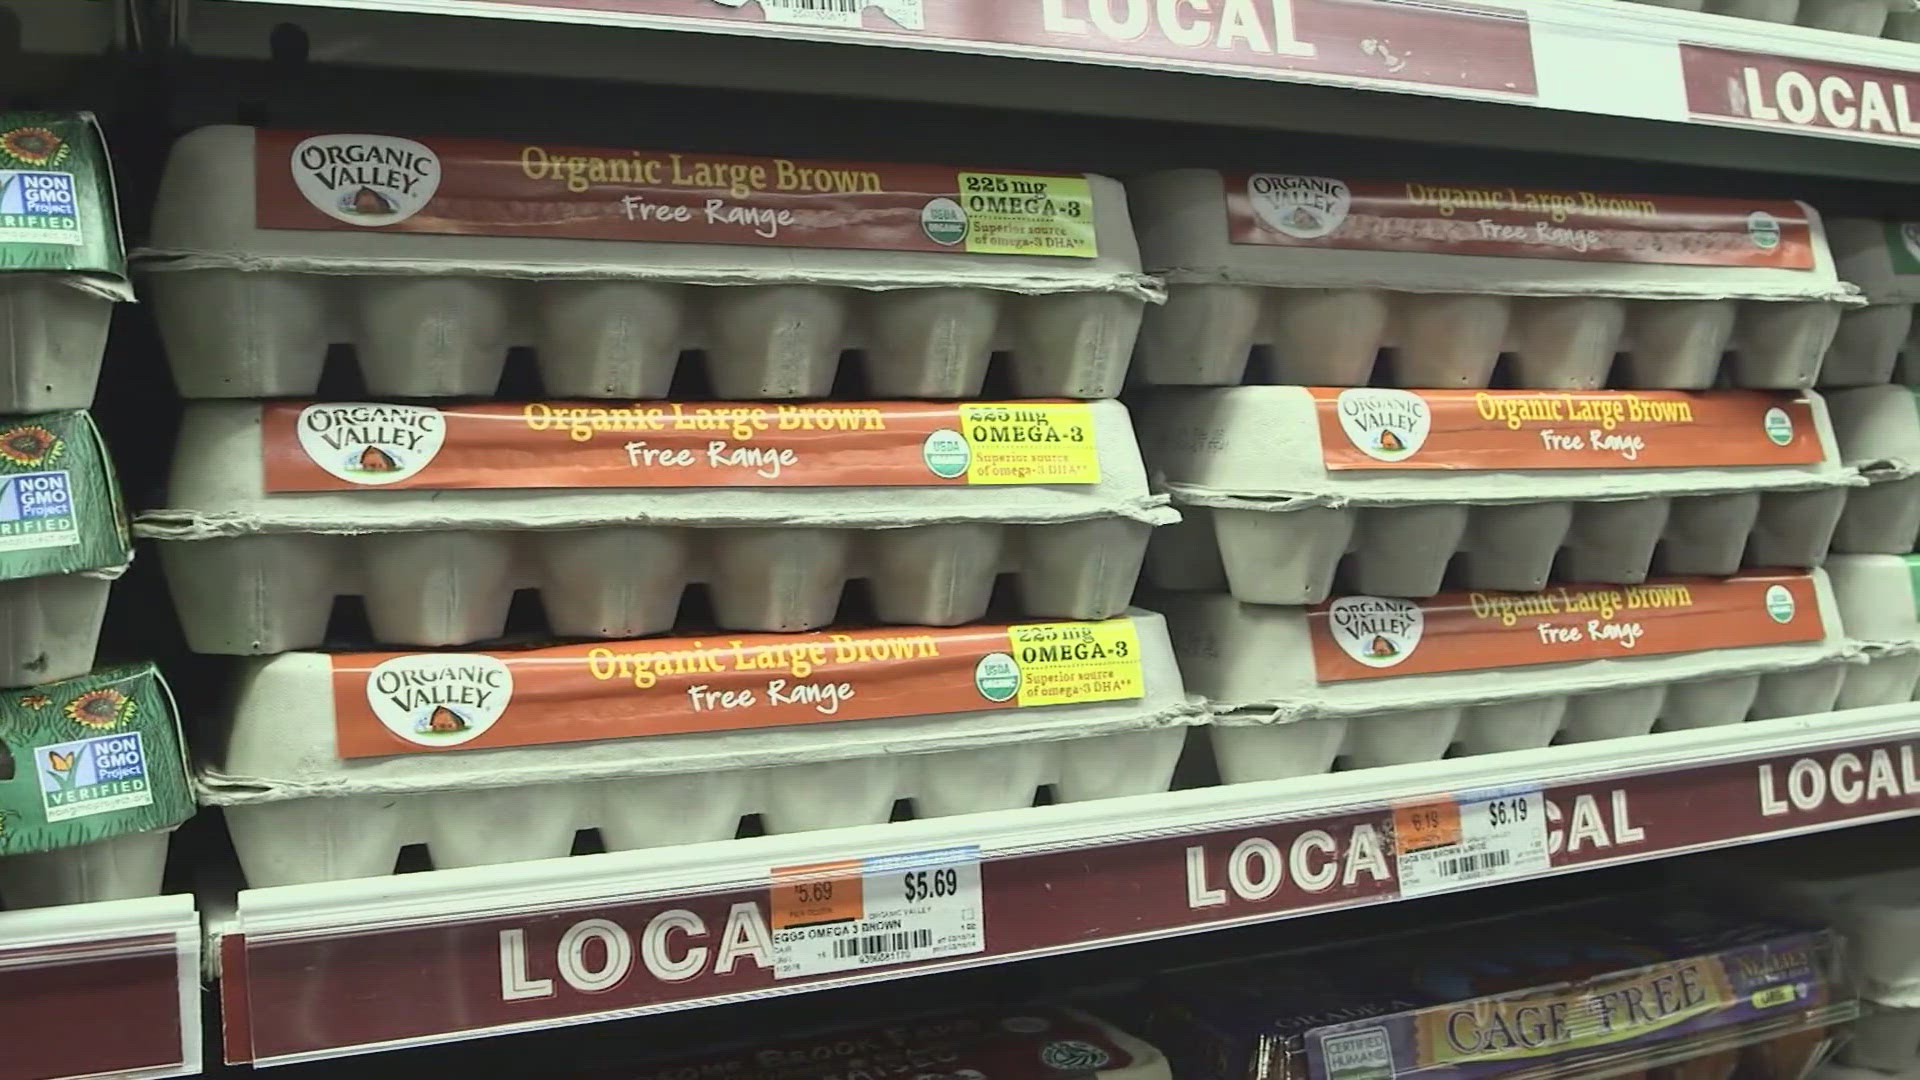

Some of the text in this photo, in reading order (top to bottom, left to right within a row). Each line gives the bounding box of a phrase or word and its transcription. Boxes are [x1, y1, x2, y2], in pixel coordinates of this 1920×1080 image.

[1043, 0, 1316, 56] LOCAL
[1744, 67, 1920, 134] LOCAL
[301, 145, 432, 176] ORGANIC
[521, 146, 883, 199] Organic Large Brown
[23, 175, 69, 190] NON
[314, 165, 419, 194] VALLEY
[966, 176, 1047, 199] 225 mg
[1253, 177, 1344, 198] ORGANIC
[25, 188, 71, 203] GMO
[969, 195, 1081, 218] OMEGA-3
[1406, 183, 1659, 223] Organic Large Brown
[0, 215, 75, 229] RIFIED
[621, 195, 795, 238] Free Range
[1477, 218, 1600, 253] Free Range
[307, 406, 436, 432] ORGANIC
[1343, 395, 1423, 417] ORGANIC
[1475, 391, 1693, 430] Organic Large Brown
[523, 402, 886, 441] Organic Large Brown
[972, 425, 1084, 443] OMEGA-3
[1354, 412, 1417, 432] VALLEY
[321, 426, 424, 451] VALLEY
[1541, 429, 1645, 461] Free Range
[624, 440, 798, 478] Free Range
[19, 477, 63, 492] NON
[21, 489, 66, 505] GMO
[0, 518, 71, 535] RIFIED
[1335, 602, 1416, 625] ORGANIC
[1470, 583, 1693, 626] Organic Large Brown
[1345, 618, 1411, 640] VALLEY
[1537, 619, 1644, 648] Free Range
[588, 634, 939, 688] Organic Large Brown
[1022, 641, 1129, 663] OMEGA-3
[376, 665, 502, 694] ORGANIC
[1025, 671, 1075, 686] Superior
[391, 685, 492, 712] VALLEY
[688, 679, 855, 715] Free Range
[95, 737, 136, 756] NON
[97, 751, 140, 768] GMO
[99, 766, 142, 780] Project
[1758, 745, 1920, 816] LOCAL
[52, 779, 144, 805] VERIFIED
[1488, 797, 1528, 829] $6.19
[1186, 823, 1391, 908] LOCA
[904, 868, 957, 904] $5.69
[774, 919, 902, 944] EGGS OMEGA 3 BROWN
[499, 901, 775, 1000] LOCA
[1448, 965, 1706, 1054] CAGE FREE
